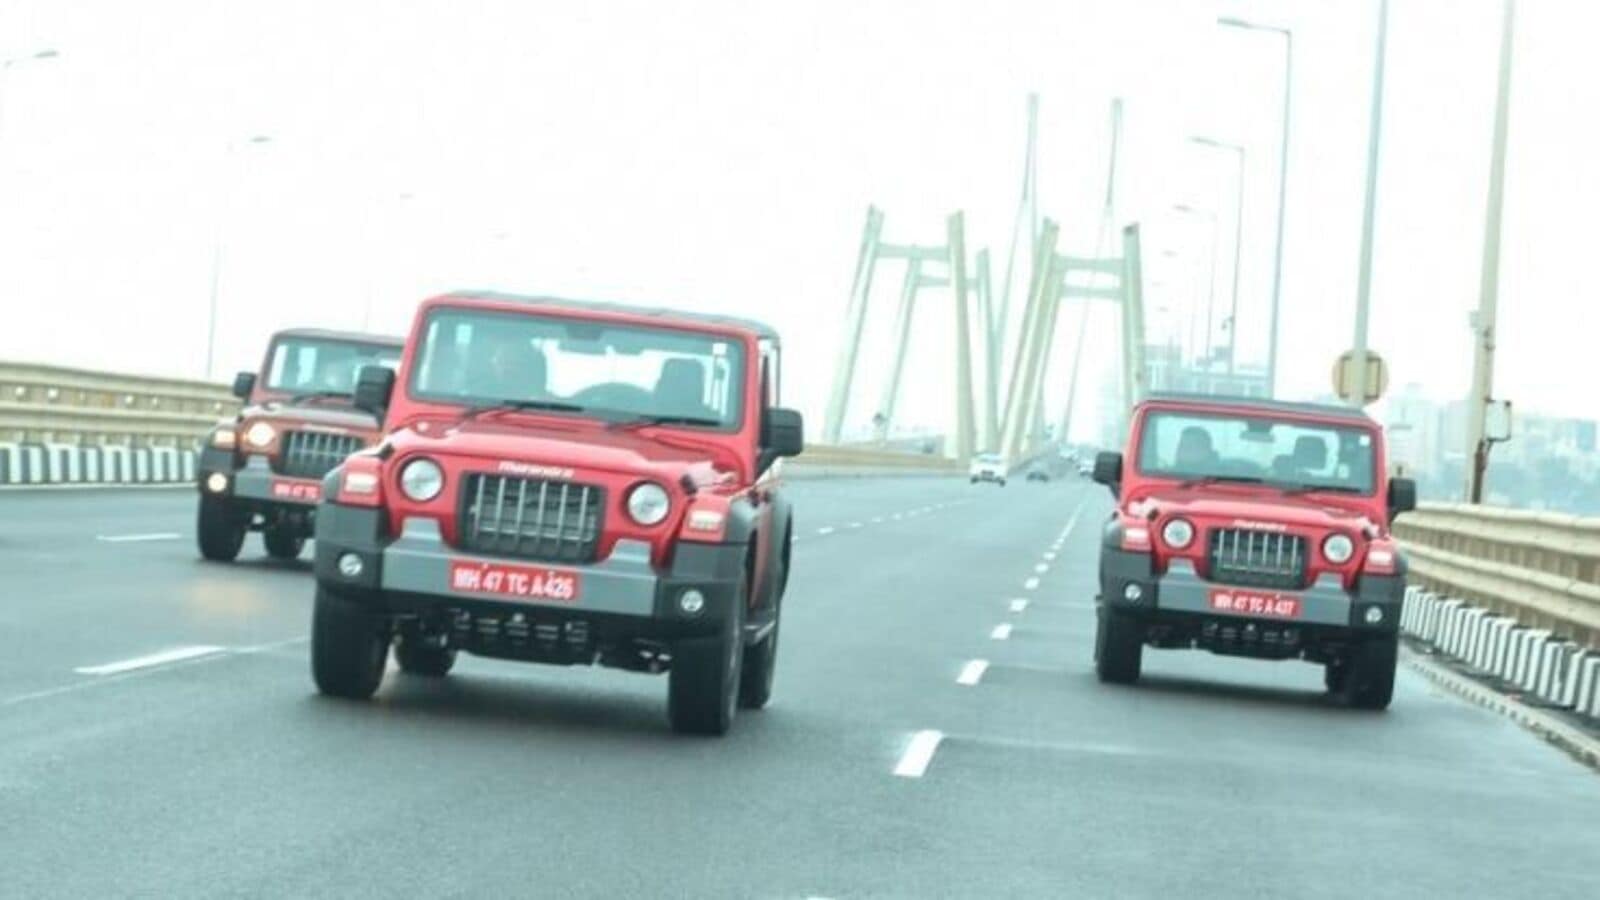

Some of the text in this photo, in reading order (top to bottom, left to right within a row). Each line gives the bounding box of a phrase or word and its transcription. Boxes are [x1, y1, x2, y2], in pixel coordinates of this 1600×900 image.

[453, 567, 481, 589] MH
[482, 570, 505, 593] 47
[506, 573, 529, 595] TC
